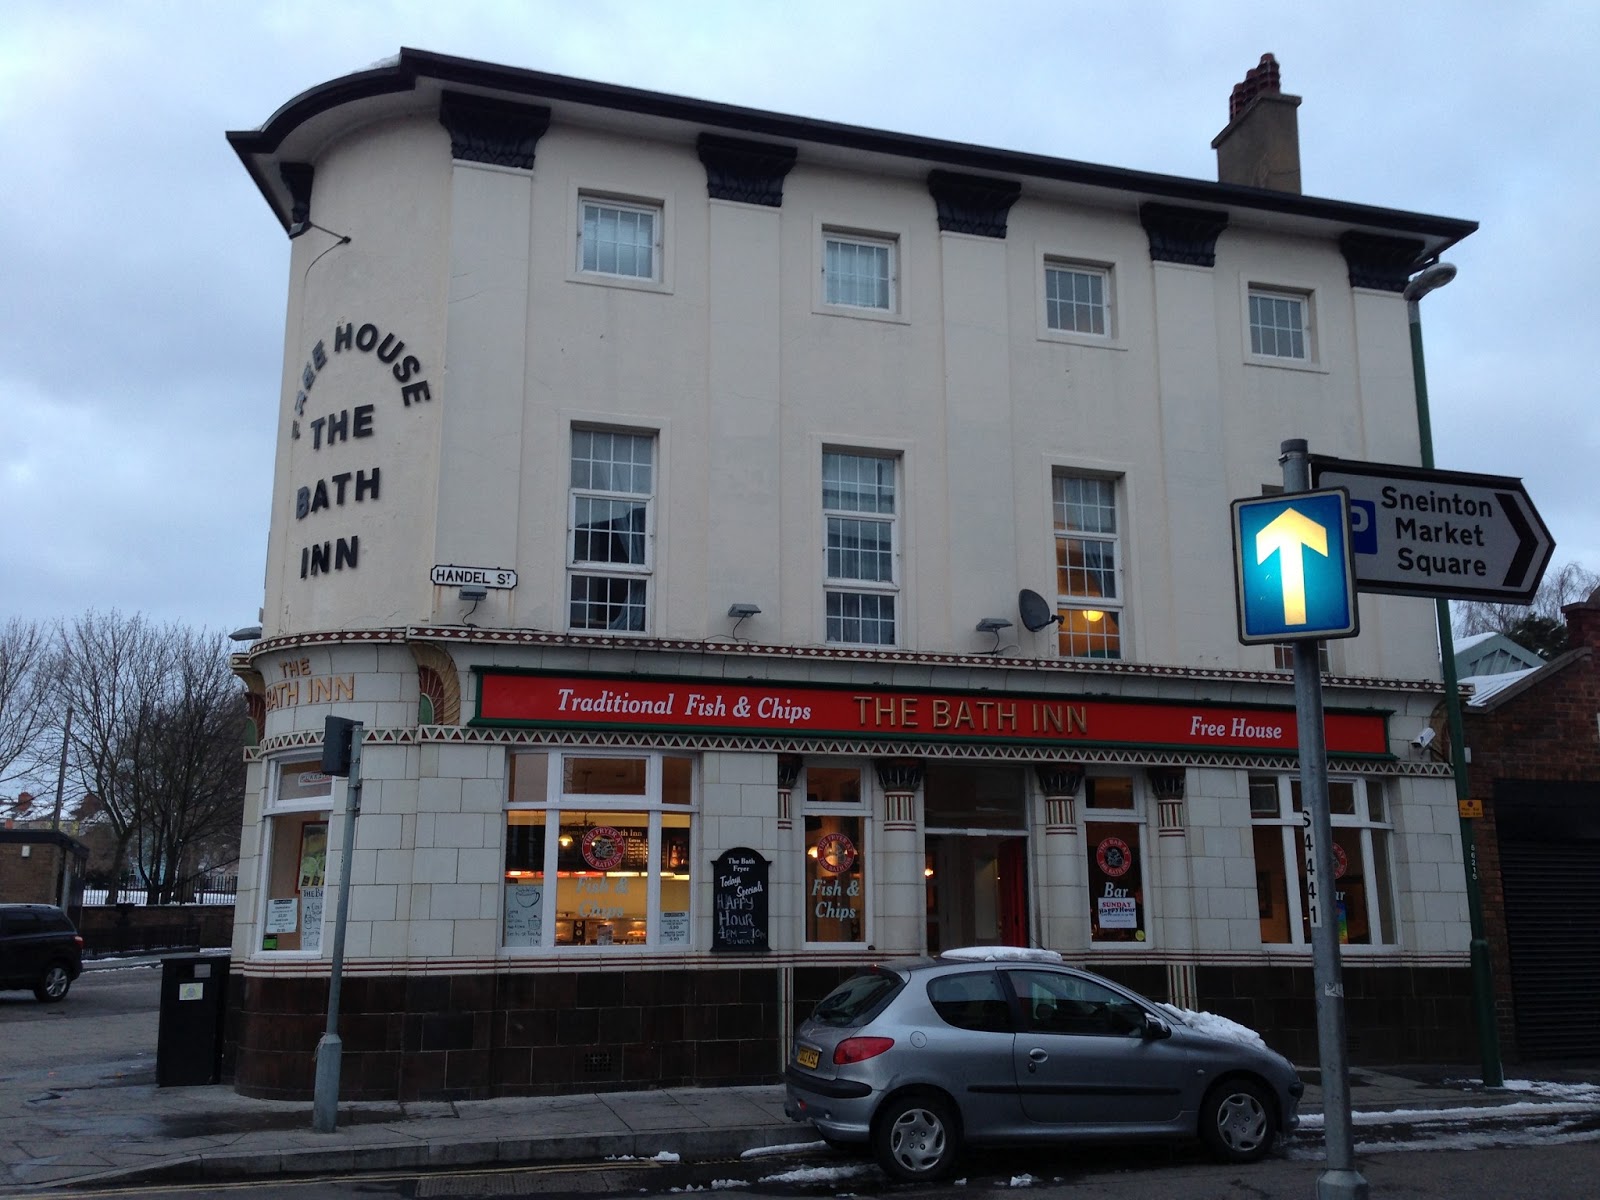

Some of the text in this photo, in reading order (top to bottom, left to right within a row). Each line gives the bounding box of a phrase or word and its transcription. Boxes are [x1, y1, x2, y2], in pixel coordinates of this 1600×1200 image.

[334, 322, 431, 407] HOUSE
[310, 404, 374, 450] THE
[296, 467, 380, 520] BATH
[1381, 486, 1493, 518] Sneinton
[1395, 517, 1485, 547] Market
[300, 535, 359, 580] INN
[1397, 547, 1487, 577] Square
[436, 569, 491, 584] HANDEL
[280, 658, 312, 678] THE
[266, 673, 355, 711] BATH INN
[558, 688, 812, 724] Traditional Fish & Chips
[854, 696, 1088, 734] THE BATH INN
[1190, 716, 1282, 739] Free House
[594, 827, 617, 838] FRYER
[733, 865, 750, 873] Fryer
[741, 857, 756, 865] Bath
[1302, 810, 1317, 924] S4441
[576, 877, 610, 894] Fish
[811, 879, 860, 897] Fish &
[1104, 882, 1128, 898] Bar
[578, 900, 624, 920] Chips
[815, 901, 856, 922] Chips
